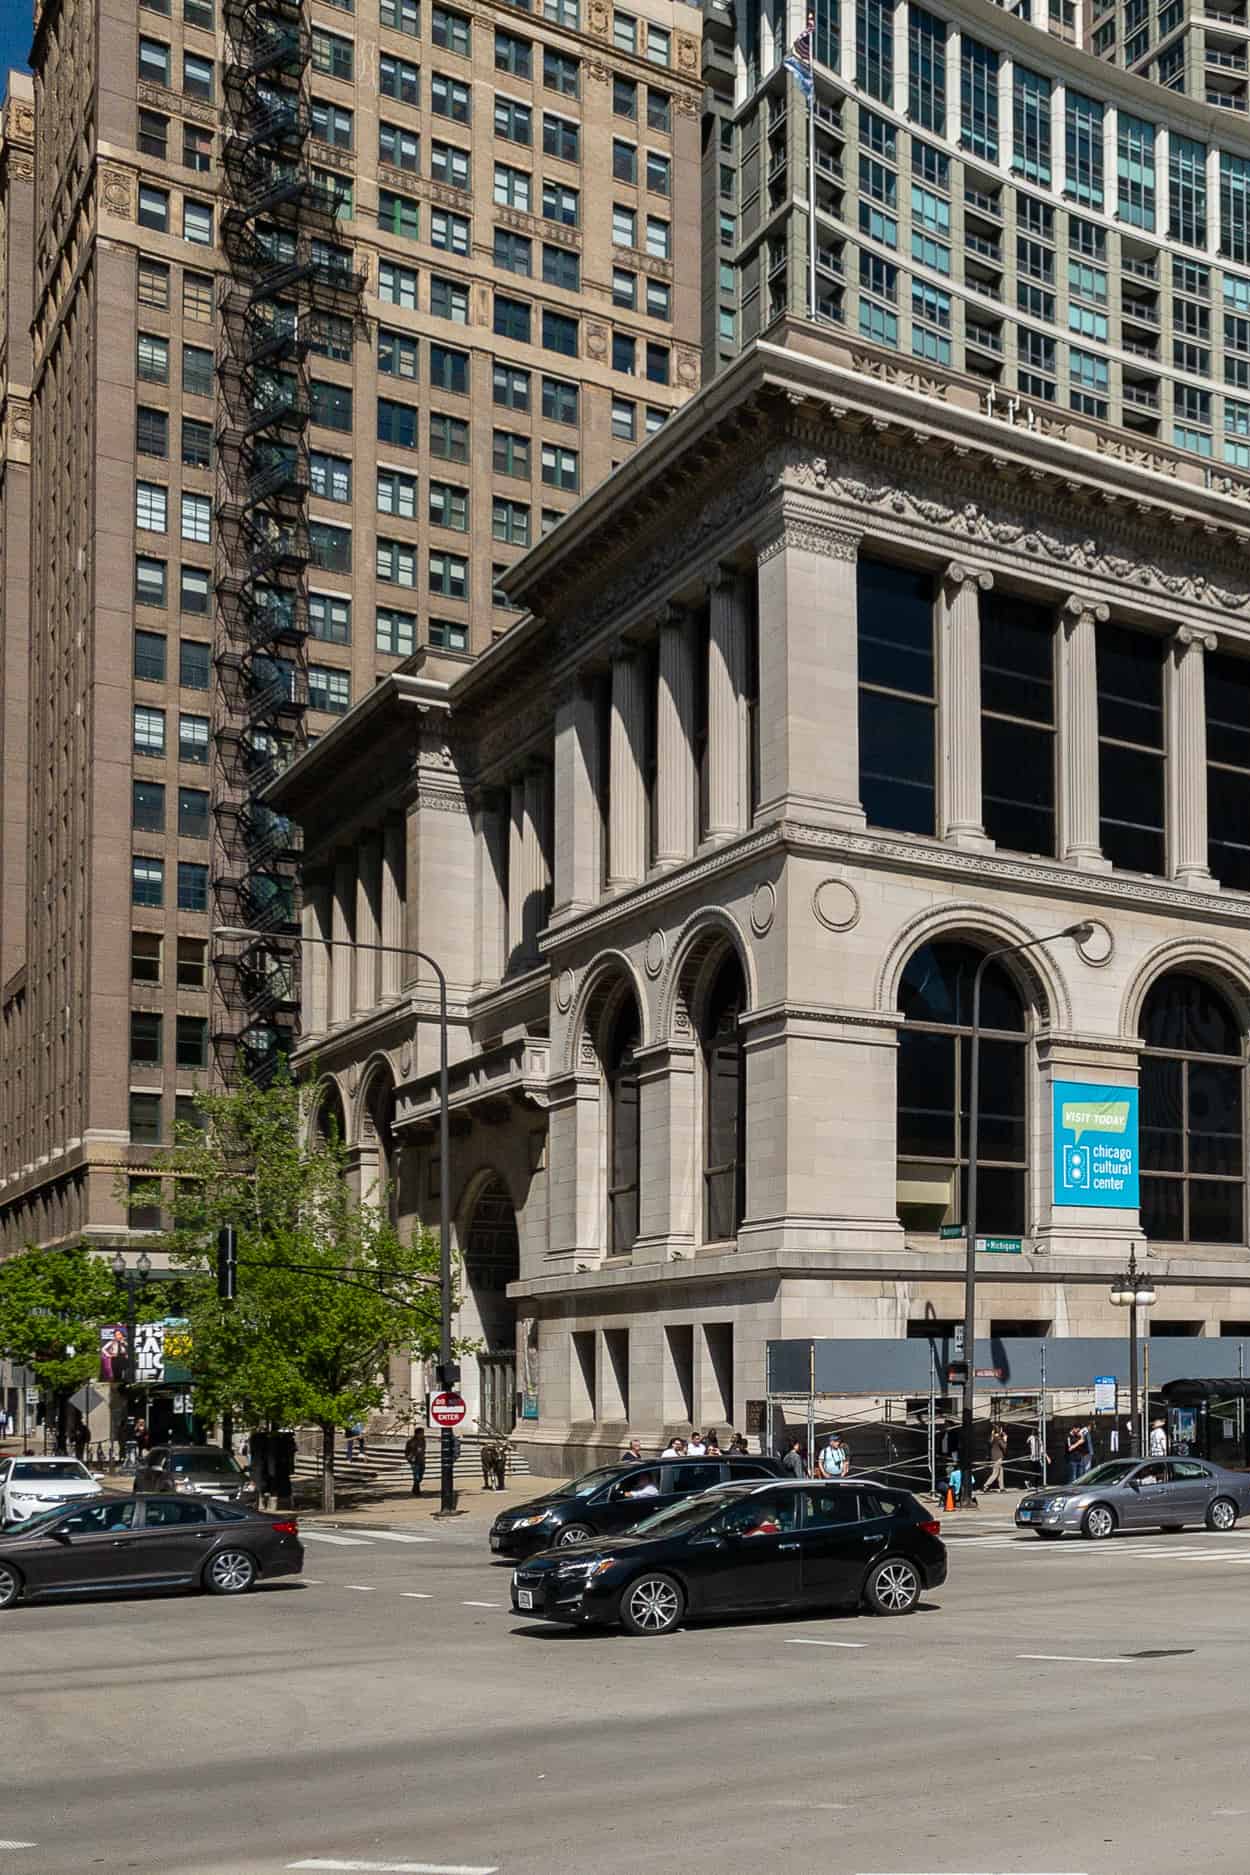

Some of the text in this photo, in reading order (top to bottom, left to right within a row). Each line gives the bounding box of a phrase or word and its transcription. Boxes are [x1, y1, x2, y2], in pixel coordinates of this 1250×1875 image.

[1065, 1111, 1125, 1125] VISIT TODAY
[1093, 1144, 1132, 1161] chicago
[1093, 1160, 1131, 1175] cultural
[1093, 1176, 1124, 1190] center
[990, 1240, 1015, 1251] Michigan
